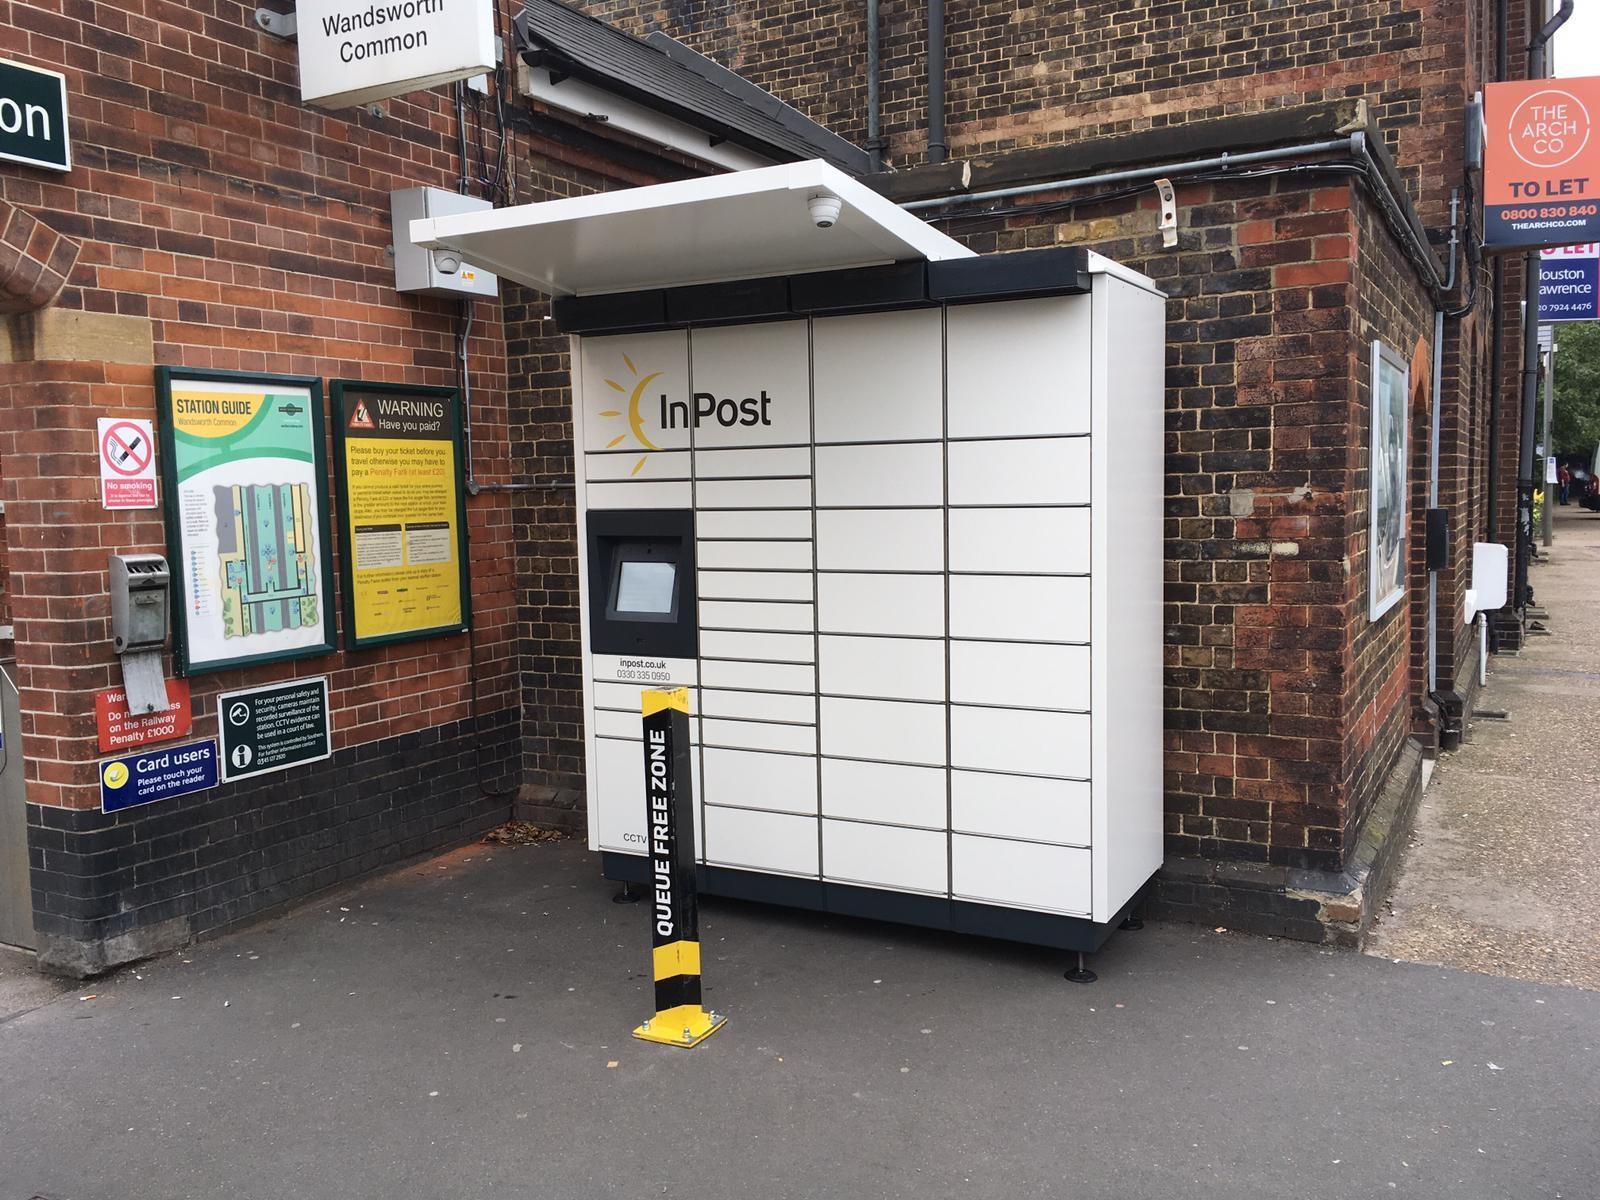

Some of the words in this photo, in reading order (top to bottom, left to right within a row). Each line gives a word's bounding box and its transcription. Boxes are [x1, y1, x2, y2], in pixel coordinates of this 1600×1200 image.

[321, 0, 443, 37] Wandsworth
[339, 30, 428, 63] Common
[1530, 104, 1568, 121] THE
[1521, 121, 1577, 139] ARCH
[1533, 138, 1564, 154] CO
[1508, 181, 1541, 198] TO
[1545, 178, 1590, 197] LET
[1501, 209, 1538, 221] 0800
[1540, 206, 1567, 219] 830
[1568, 204, 1597, 217] 840
[1511, 218, 1587, 231] THEARCHCO.COM
[1538, 283, 1592, 296] awrence
[1549, 302, 1569, 313] 7924
[1570, 301, 1593, 312] 4476
[176, 398, 220, 415] STATION
[221, 399, 252, 416] GUIDE
[376, 398, 444, 419] WARNING
[660, 390, 772, 430] InPost
[378, 418, 401, 431] Have
[402, 420, 418, 433] you
[418, 420, 442, 433] paid?
[350, 446, 372, 455] Please
[372, 446, 385, 456] buy
[385, 447, 399, 457] your
[399, 447, 415, 455] ticket
[416, 447, 434, 456] before
[435, 448, 446, 457] you
[350, 457, 369, 465] travel
[369, 457, 398, 466] otherwise
[399, 458, 411, 467] you
[411, 459, 424, 467] may
[424, 458, 439, 466] have
[439, 458, 446, 466] to
[351, 469, 364, 477] pay
[106, 482, 118, 490] No
[119, 482, 153, 492] smoking
[620, 657, 667, 670] inpost.co.uk
[617, 669, 636, 679] 0330
[636, 670, 651, 680] 335
[651, 671, 671, 681] 0950
[255, 698, 263, 706] For
[263, 696, 275, 706] your
[275, 692, 296, 703] personal
[296, 689, 310, 698] safety
[310, 688, 320, 696] and
[108, 711, 121, 721] Do
[109, 724, 121, 733] on
[124, 720, 139, 731] the
[141, 714, 176, 728] Railway
[256, 712, 278, 723] recorded
[275, 718, 290, 727] CCTV
[290, 715, 311, 724] evidence
[110, 731, 145, 745] Penalty
[147, 725, 175, 738] £1000
[256, 732, 264, 740] be
[264, 729, 276, 738] used
[286, 725, 300, 733] court
[136, 753, 169, 773] Card
[173, 748, 211, 765] users
[650, 729, 667, 792] ZONE
[137, 776, 162, 787] Please
[163, 769, 185, 781] touch
[186, 766, 203, 777] your
[138, 786, 155, 796] card
[156, 783, 166, 792] on
[167, 779, 181, 789] the
[182, 774, 205, 786] reader
[651, 796, 670, 855] FREE
[623, 832, 648, 844] CCTV
[654, 859, 674, 937] QUEUE
